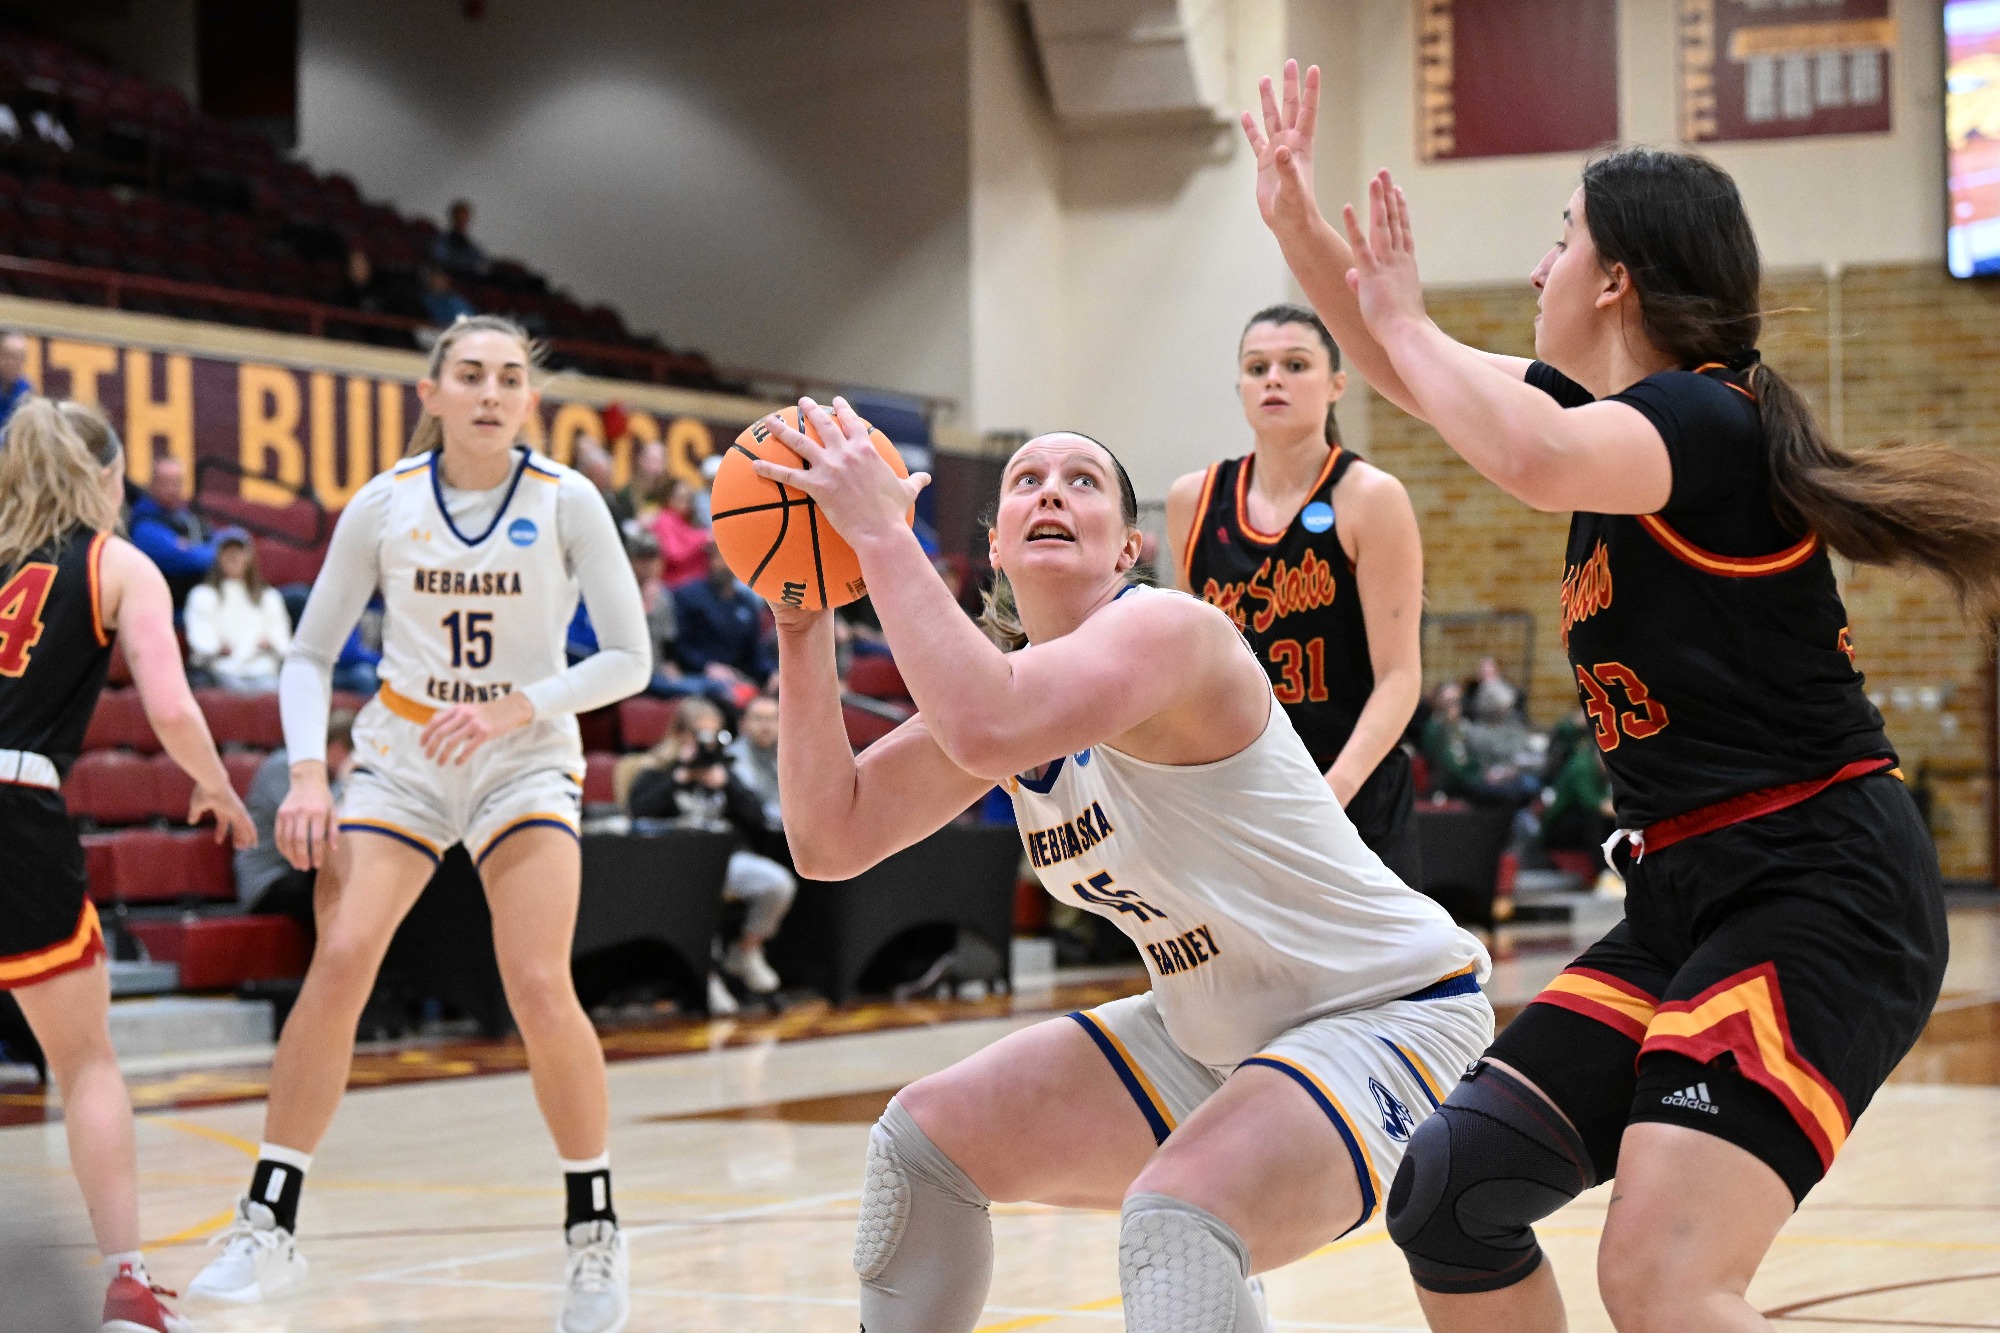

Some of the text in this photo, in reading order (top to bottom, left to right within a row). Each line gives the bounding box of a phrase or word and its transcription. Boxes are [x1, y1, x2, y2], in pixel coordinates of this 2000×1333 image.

[238, 362, 716, 512] BULOGS
[413, 567, 524, 596] NEBRASKA
[1247, 548, 1337, 634] State
[440, 610, 494, 669] 15
[1269, 637, 1329, 704] 31
[1576, 661, 1670, 753] 33
[1028, 799, 1115, 868] NEBRASKA
[1661, 1095, 1719, 1114] adidas
